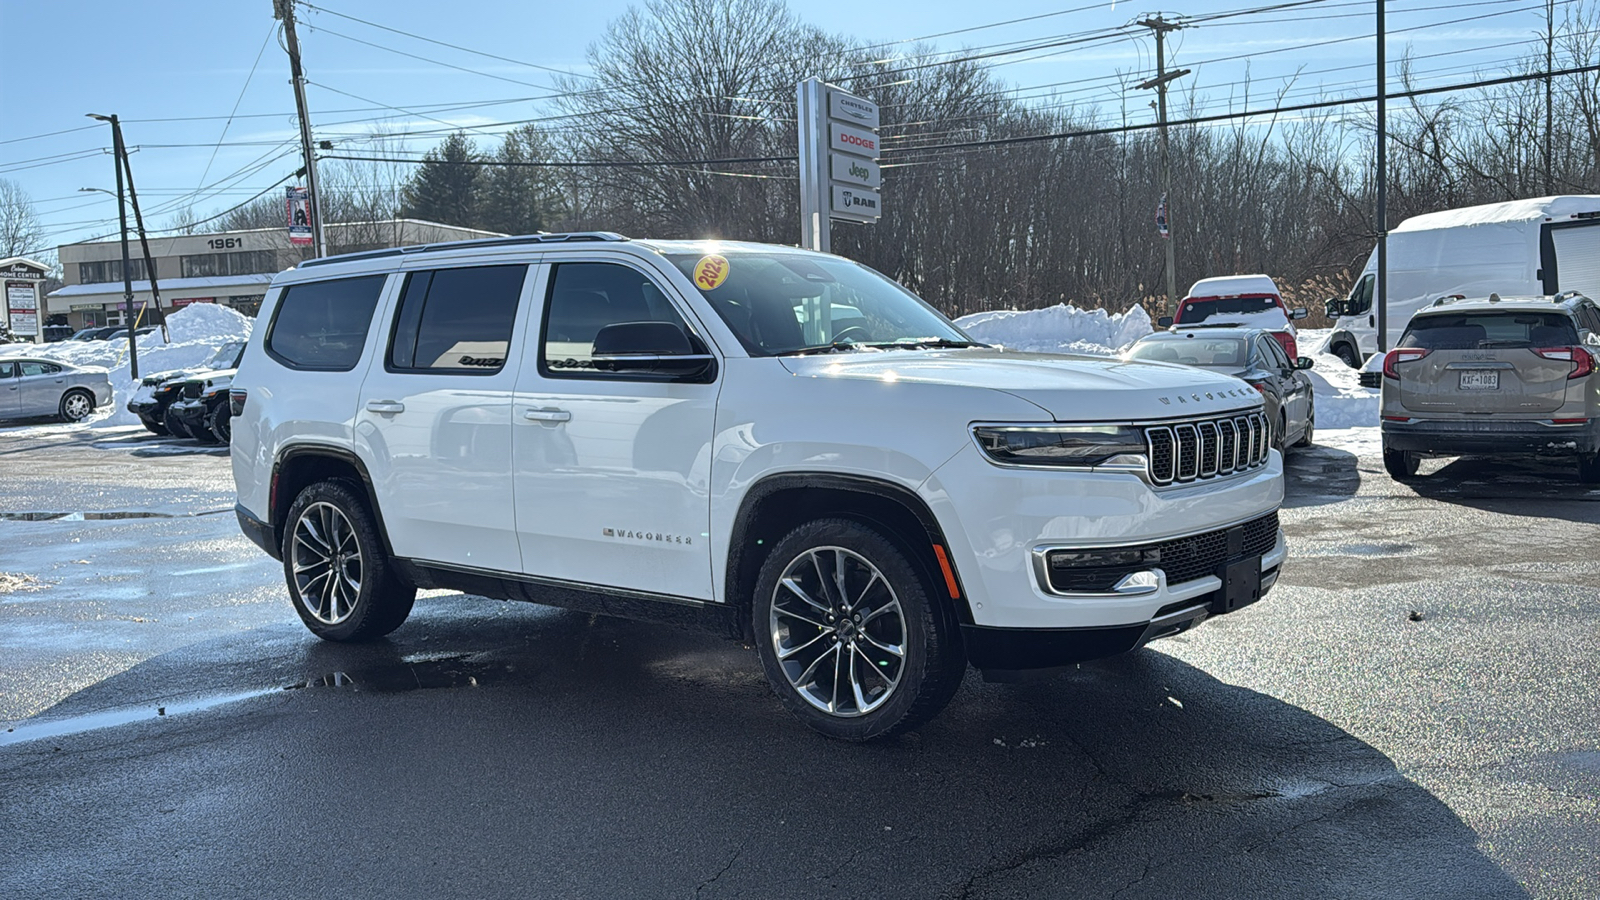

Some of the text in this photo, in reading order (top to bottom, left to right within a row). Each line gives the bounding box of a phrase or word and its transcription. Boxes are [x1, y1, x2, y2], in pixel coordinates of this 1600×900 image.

[840, 99, 873, 113] CHRYSLER
[840, 133, 875, 150] DODGE
[849, 161, 869, 181] Jeep
[853, 196, 876, 208] RAM
[207, 237, 242, 249] 1961
[698, 256, 725, 288] 2024
[1158, 387, 1255, 405] WAGONEER
[616, 529, 692, 545] WAGONEER
